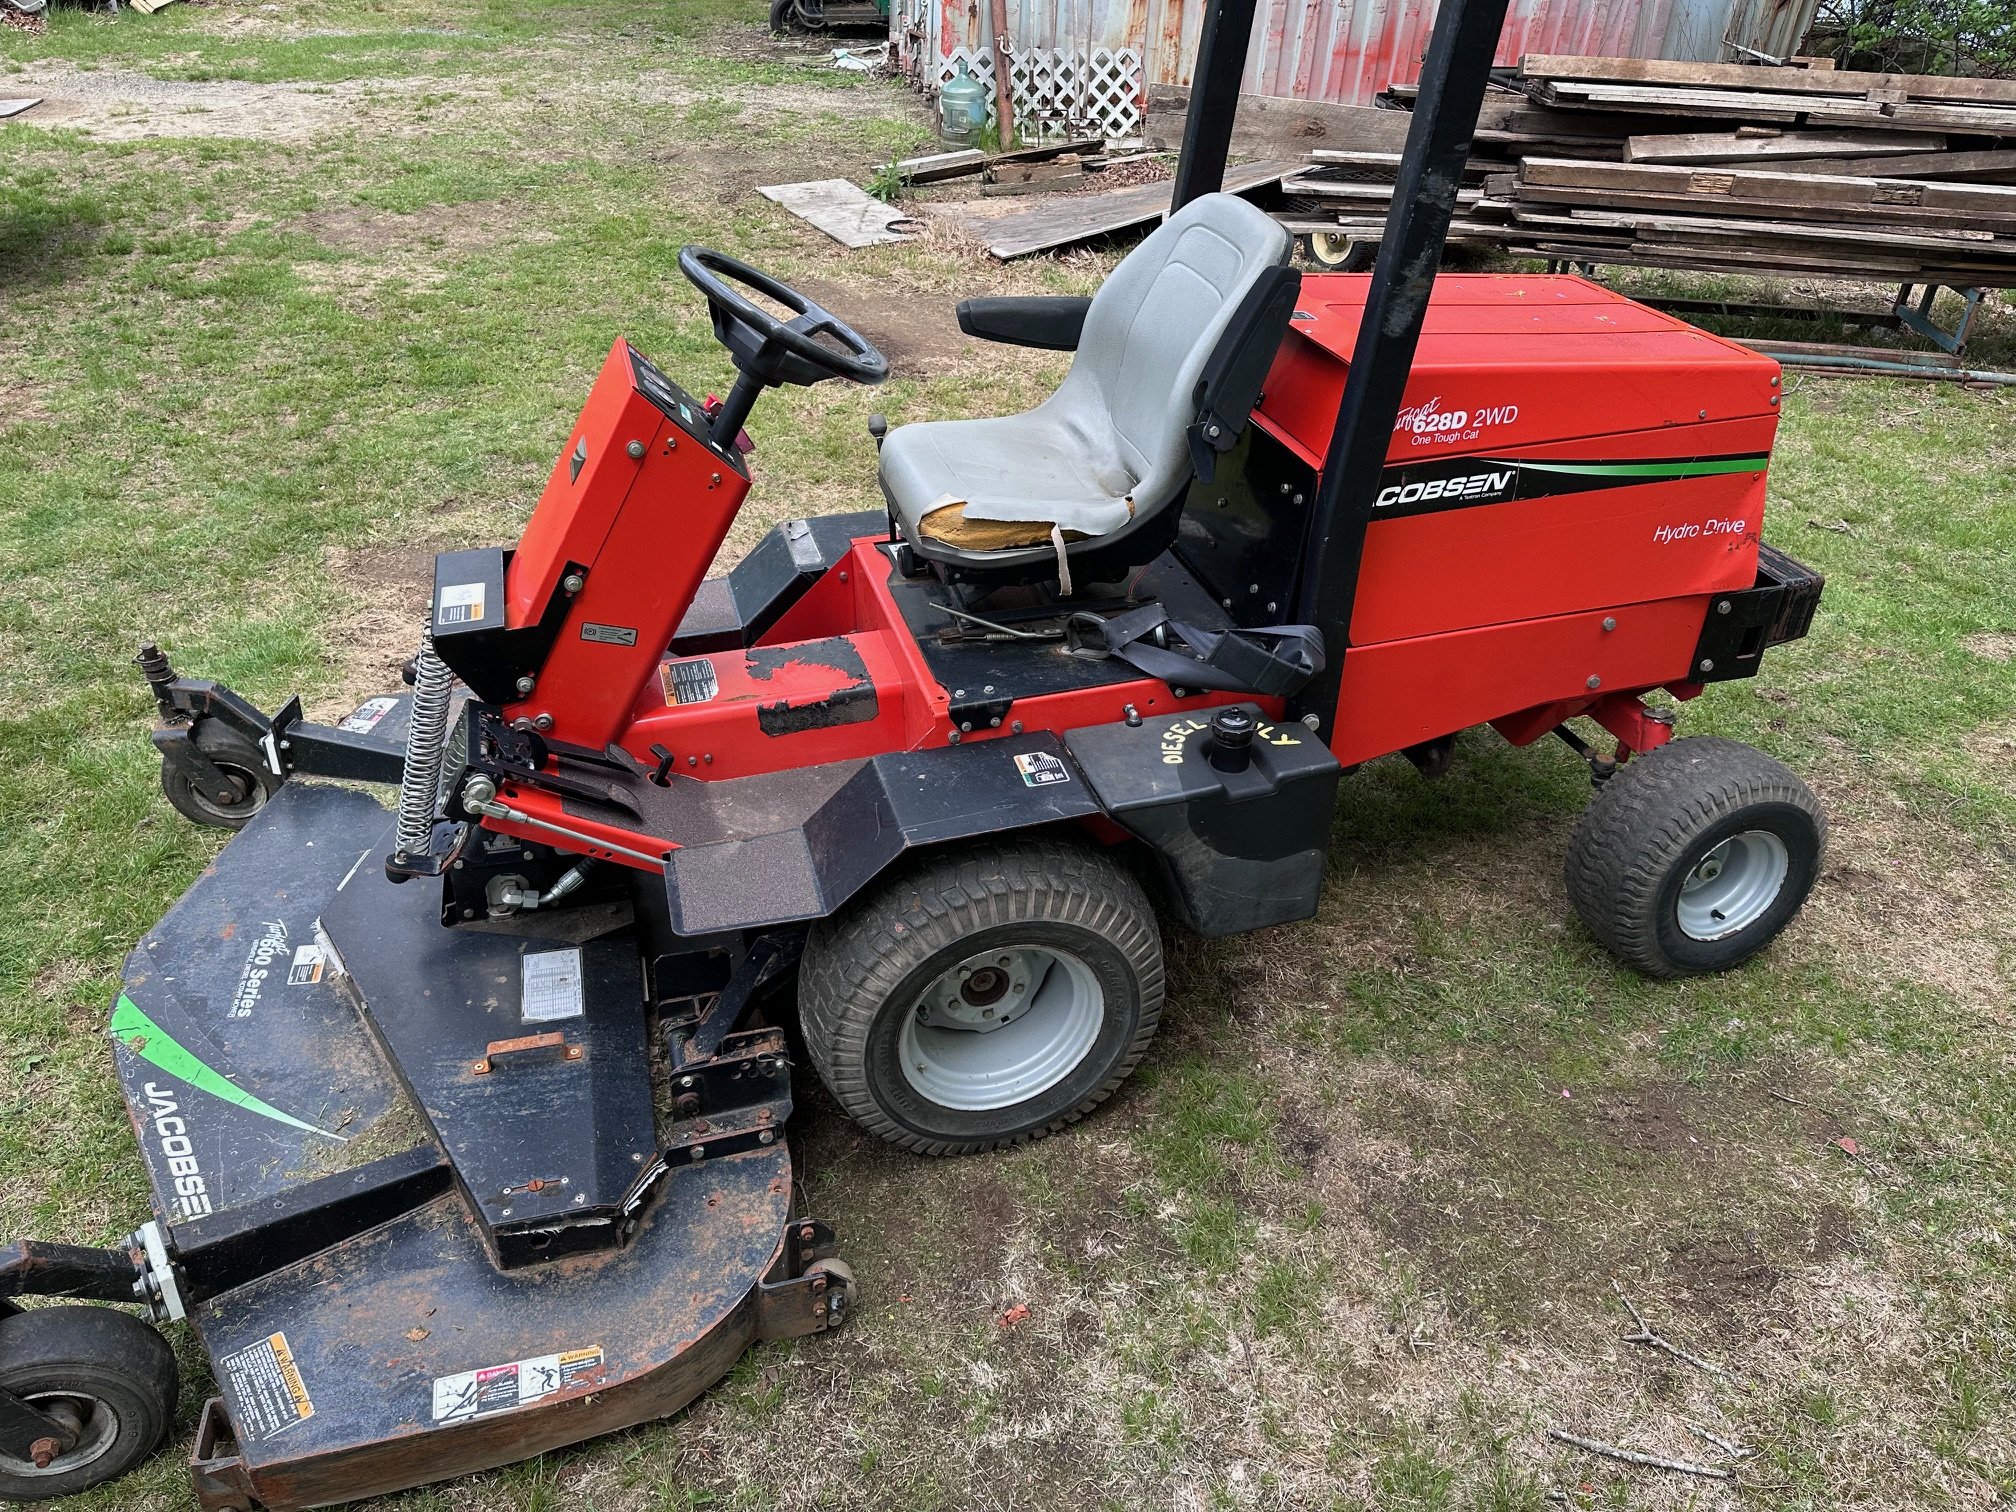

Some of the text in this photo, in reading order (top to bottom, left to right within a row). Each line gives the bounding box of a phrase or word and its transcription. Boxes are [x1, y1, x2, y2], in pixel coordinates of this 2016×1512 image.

[1411, 429, 1480, 446] One Tough Cat
[1412, 405, 1519, 434] 628D 2WD
[1372, 470, 1513, 507] COBSEN
[1653, 517, 1746, 544] Hydro Drive
[1160, 719, 1208, 764] DIESEL
[261, 918, 291, 956] Turfcat
[237, 938, 275, 1018] 600 Series
[144, 1081, 214, 1223] JACOBSE
[567, 1348, 600, 1361] WARNING
[280, 1355, 301, 1395] WARNING
